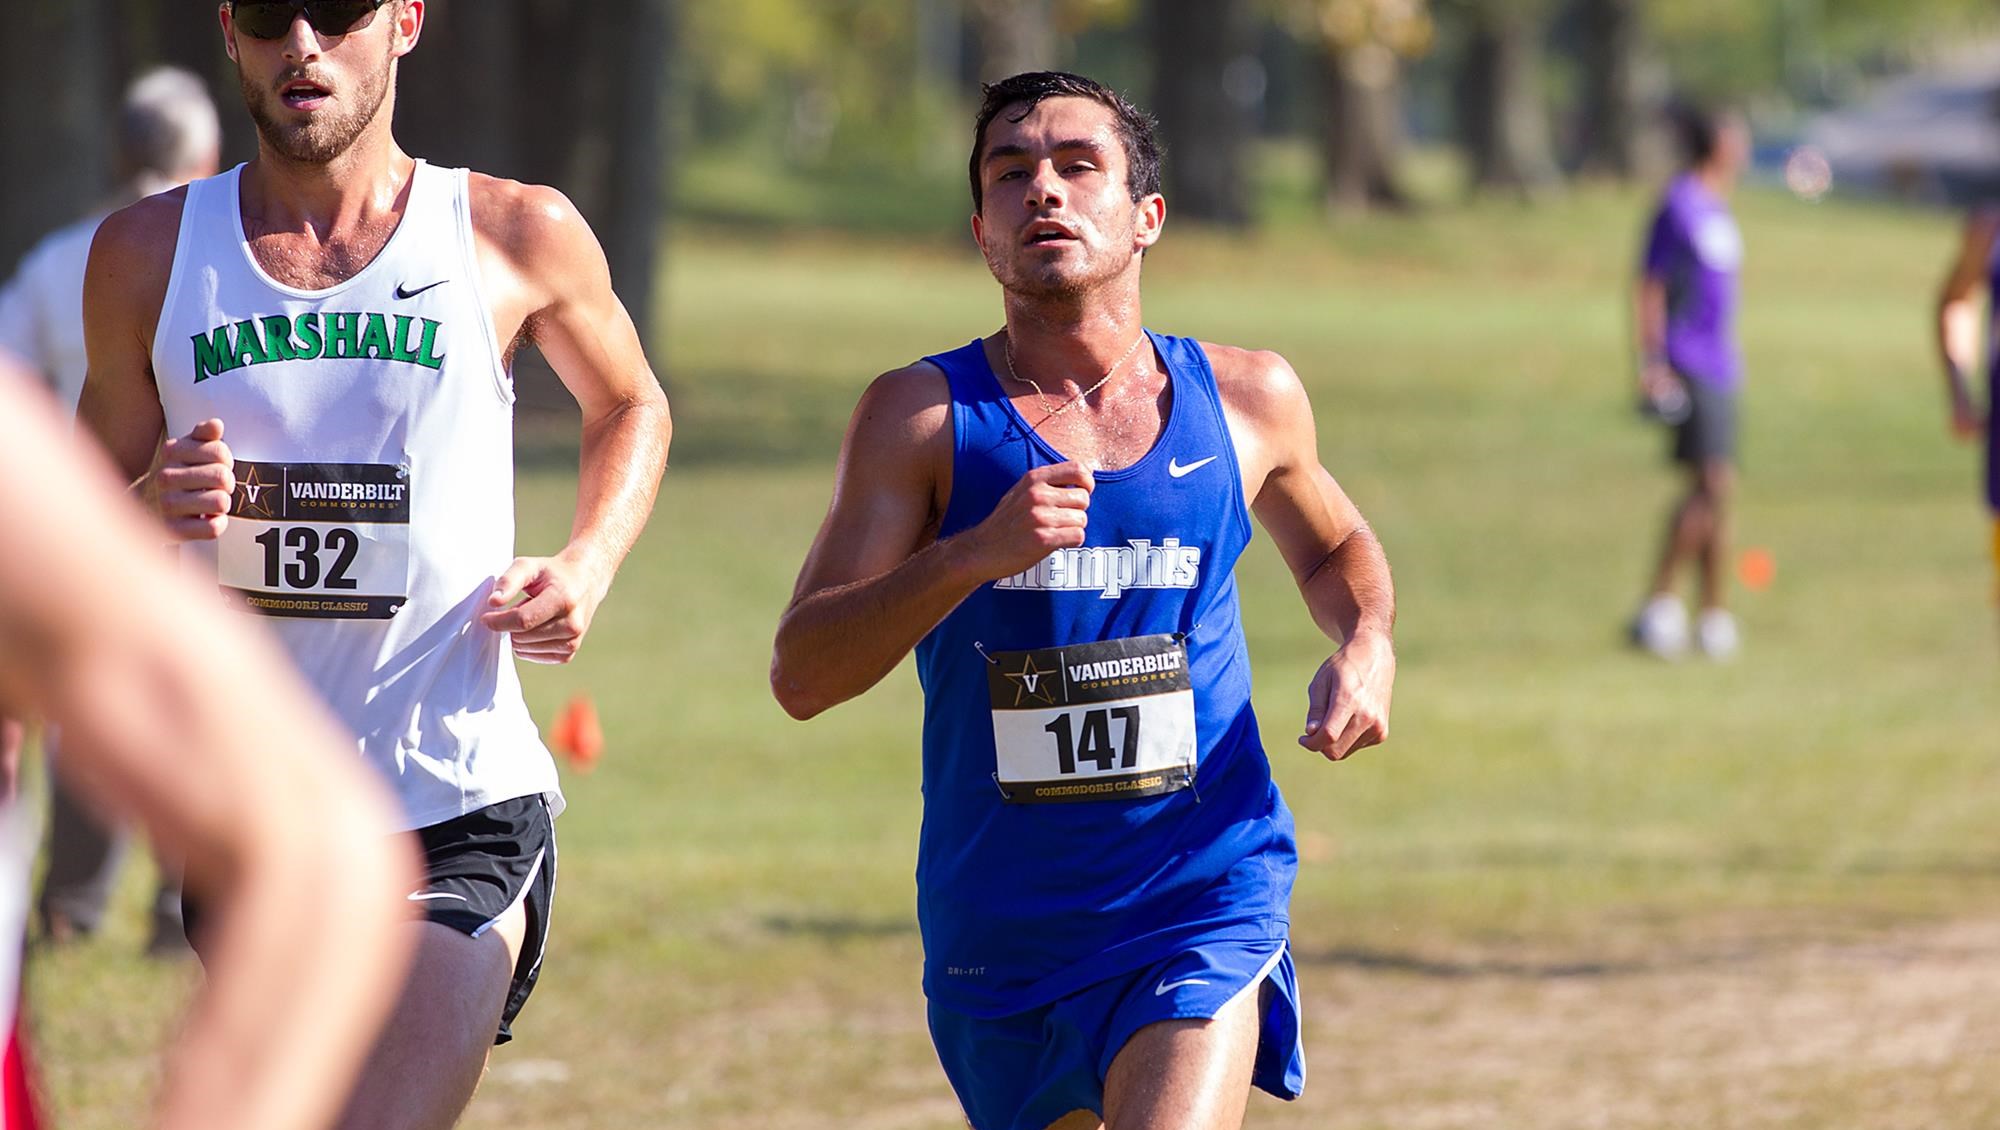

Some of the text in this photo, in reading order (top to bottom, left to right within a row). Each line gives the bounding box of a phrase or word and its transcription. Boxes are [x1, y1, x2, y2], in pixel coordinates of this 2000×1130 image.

[191, 312, 445, 383] MARSHALL
[246, 485, 260, 503] V
[290, 482, 405, 500] VANDERBILT
[300, 501, 396, 509] COMMODORES
[255, 527, 359, 589] 132
[247, 597, 368, 611] COMMODORE CLASSIC
[1069, 651, 1182, 682] VANDERBILT
[1023, 674, 1038, 693] V
[1082, 671, 1176, 689] COMMODORES
[1045, 705, 1140, 774] 147
[1035, 776, 1162, 796] COMMODORE CLASSIC
